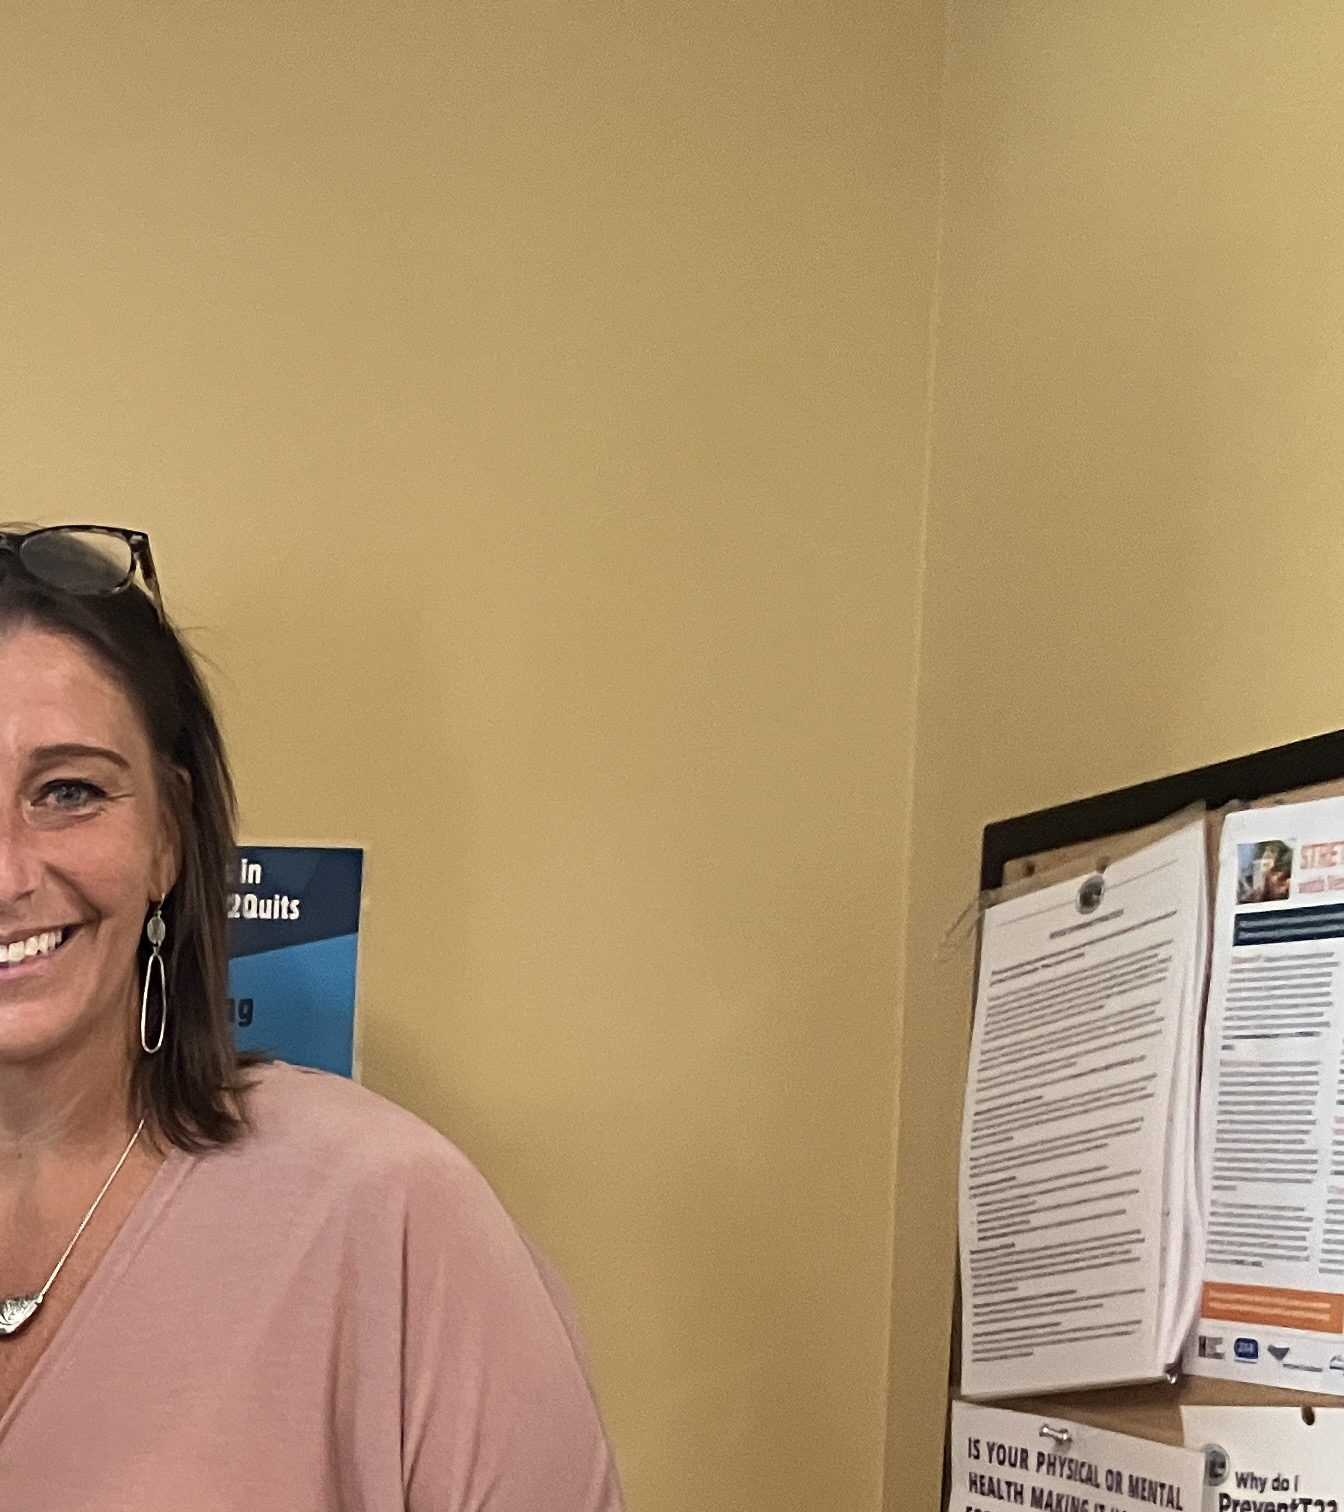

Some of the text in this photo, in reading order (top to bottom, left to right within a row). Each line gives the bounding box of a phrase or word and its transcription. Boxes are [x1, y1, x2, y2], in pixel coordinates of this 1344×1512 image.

[240, 858, 262, 885] in
[968, 1436, 1183, 1511] IS YOUR PHYSICAL OR MENTAL
[968, 1472, 1024, 1505] HEALTH
[1235, 1470, 1299, 1494] Why do I
